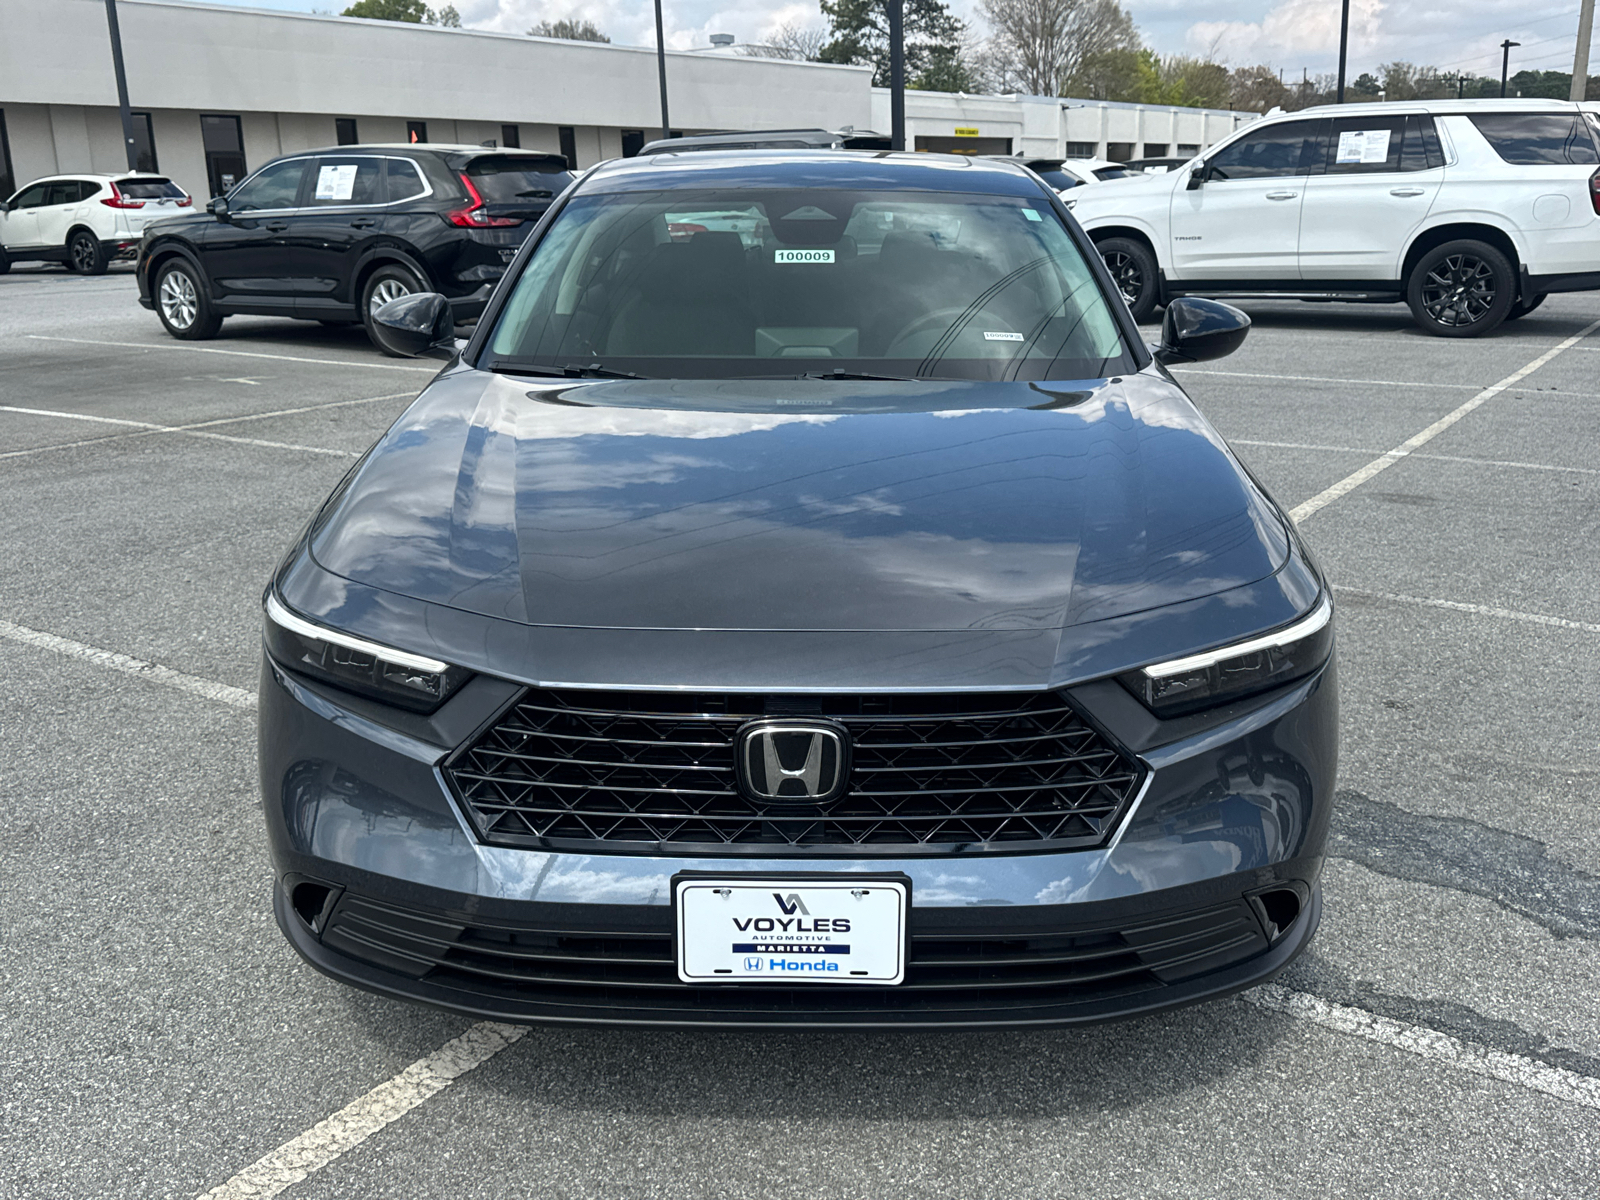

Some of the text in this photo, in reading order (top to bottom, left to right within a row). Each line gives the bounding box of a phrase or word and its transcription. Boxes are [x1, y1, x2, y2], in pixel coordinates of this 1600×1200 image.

[778, 251, 831, 261] 100009
[732, 917, 852, 932] VOYLES
[756, 944, 826, 952] MARIETTA
[769, 958, 839, 972] Honda
